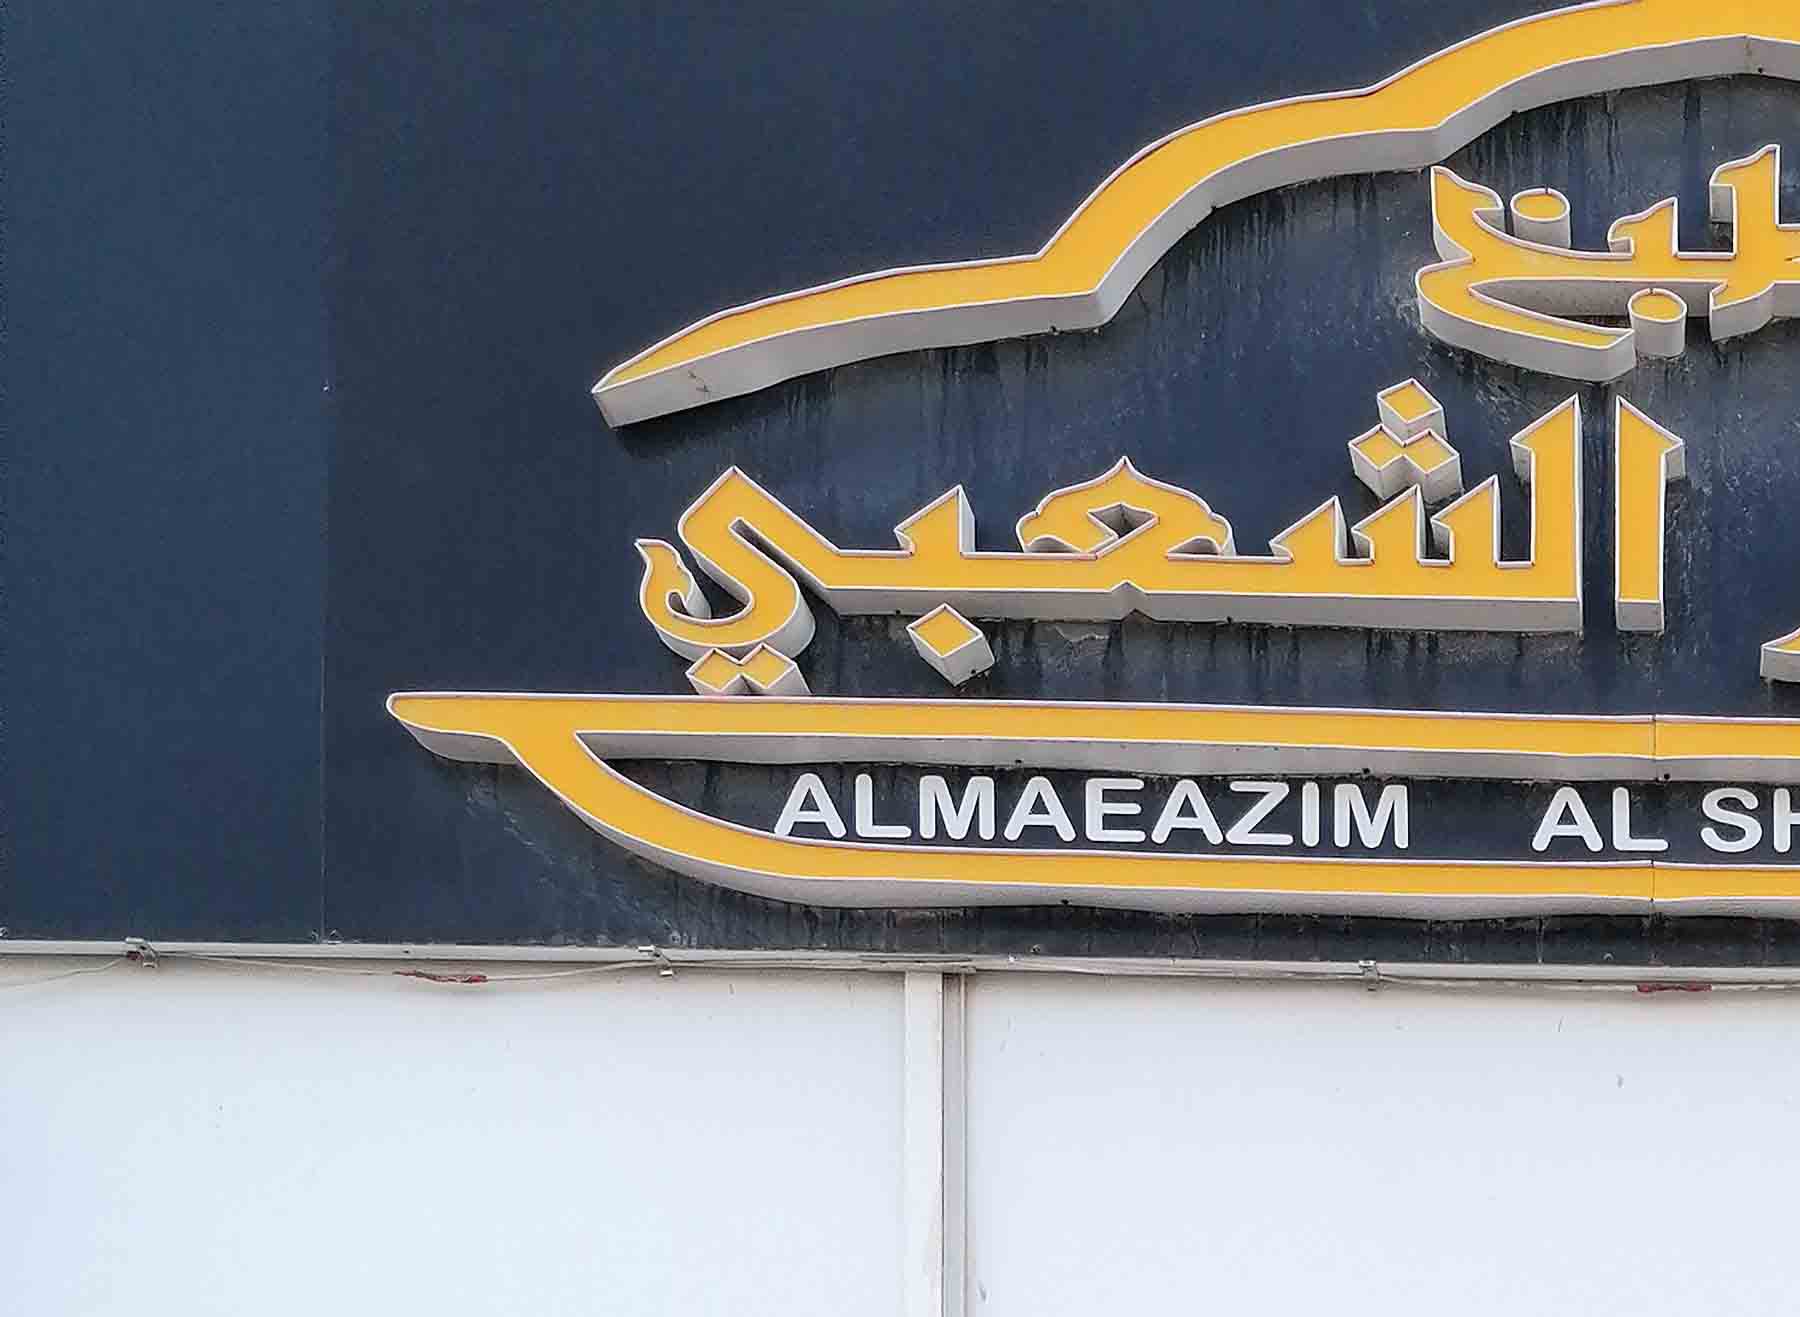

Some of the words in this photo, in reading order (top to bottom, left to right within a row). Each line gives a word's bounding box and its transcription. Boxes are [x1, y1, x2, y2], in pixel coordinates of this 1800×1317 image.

[635, 377, 1686, 694] الشعبي
[773, 772, 1411, 849] ALMAEAZIM
[1532, 786, 1668, 852] AL
